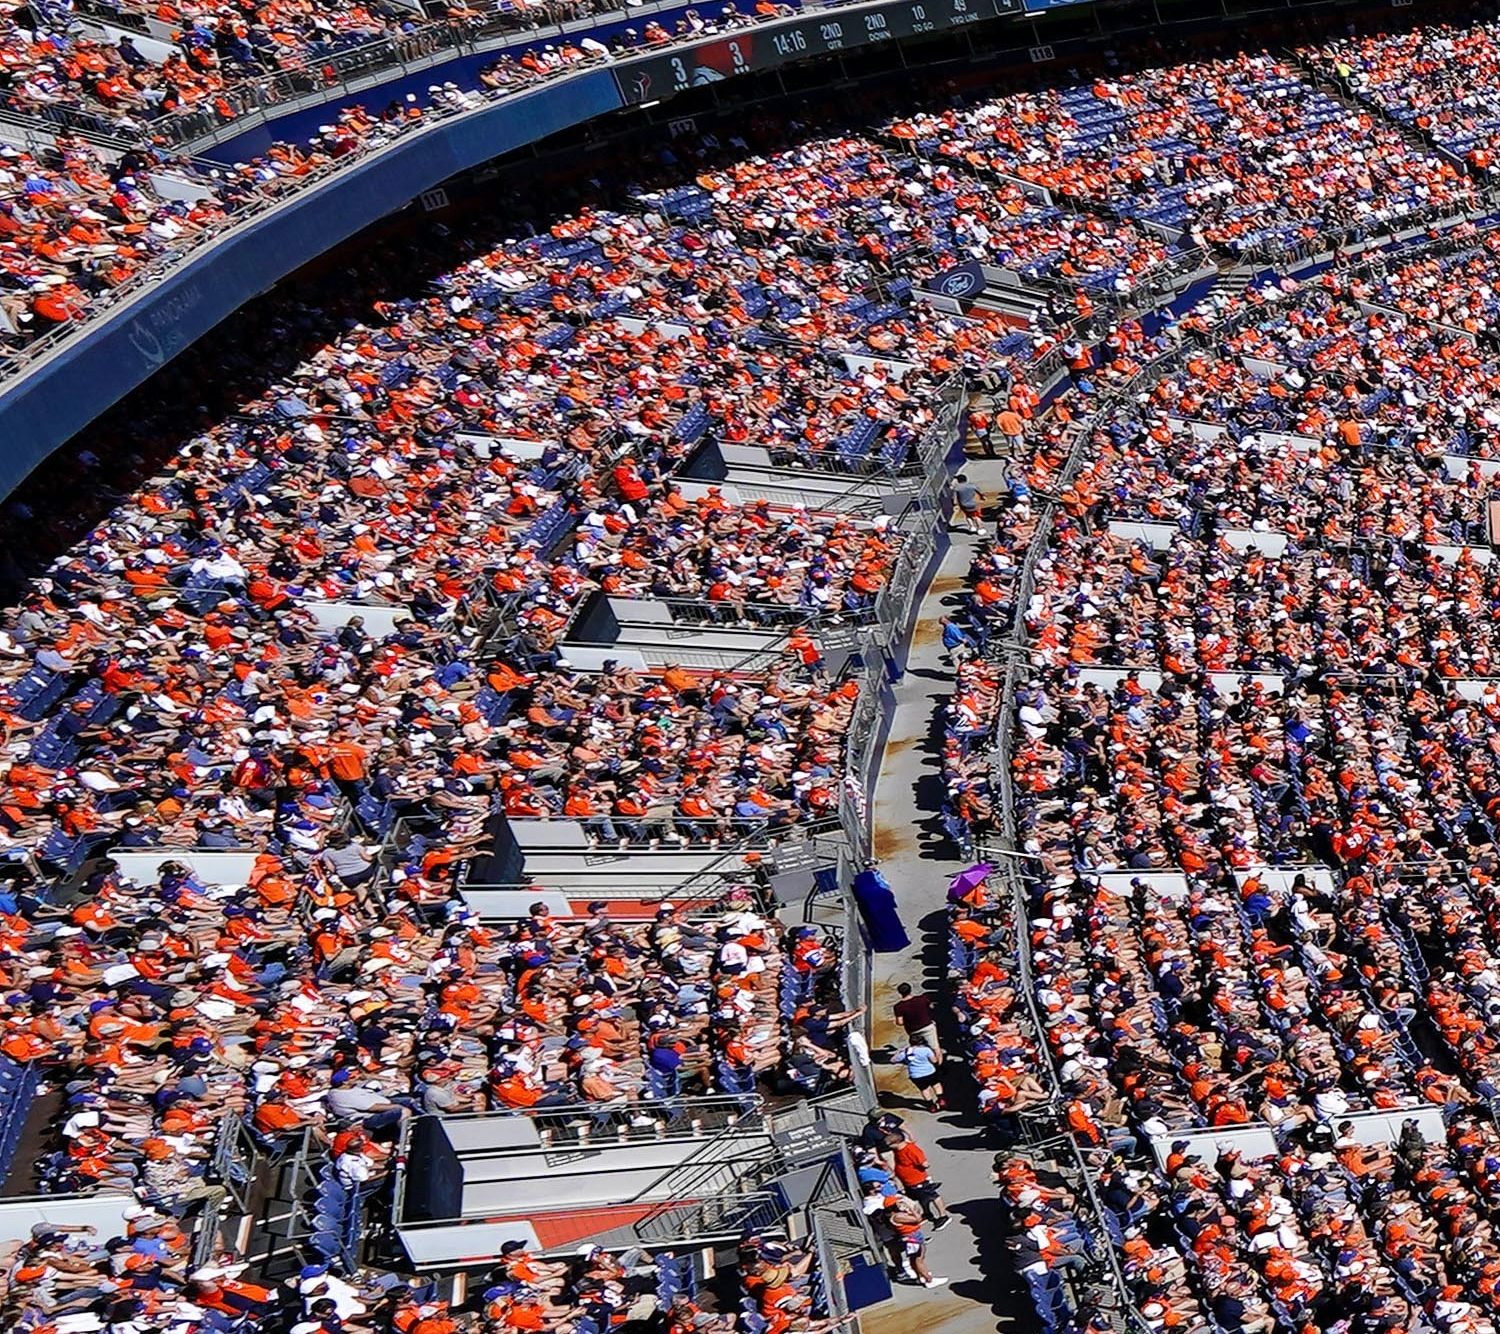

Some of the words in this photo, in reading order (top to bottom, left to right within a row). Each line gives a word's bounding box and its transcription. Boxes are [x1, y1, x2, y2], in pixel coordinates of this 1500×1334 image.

[912, 5, 925, 20] 10
[864, 13, 886, 31] 2ND
[821, 23, 843, 39] 2ND
[868, 30, 892, 43] DOWN
[773, 31, 806, 55] 14:16
[828, 41, 843, 50] QTR
[729, 42, 743, 66] 3
[1032, 47, 1052, 60] 118
[671, 57, 686, 83] 3
[424, 191, 447, 209] 117
